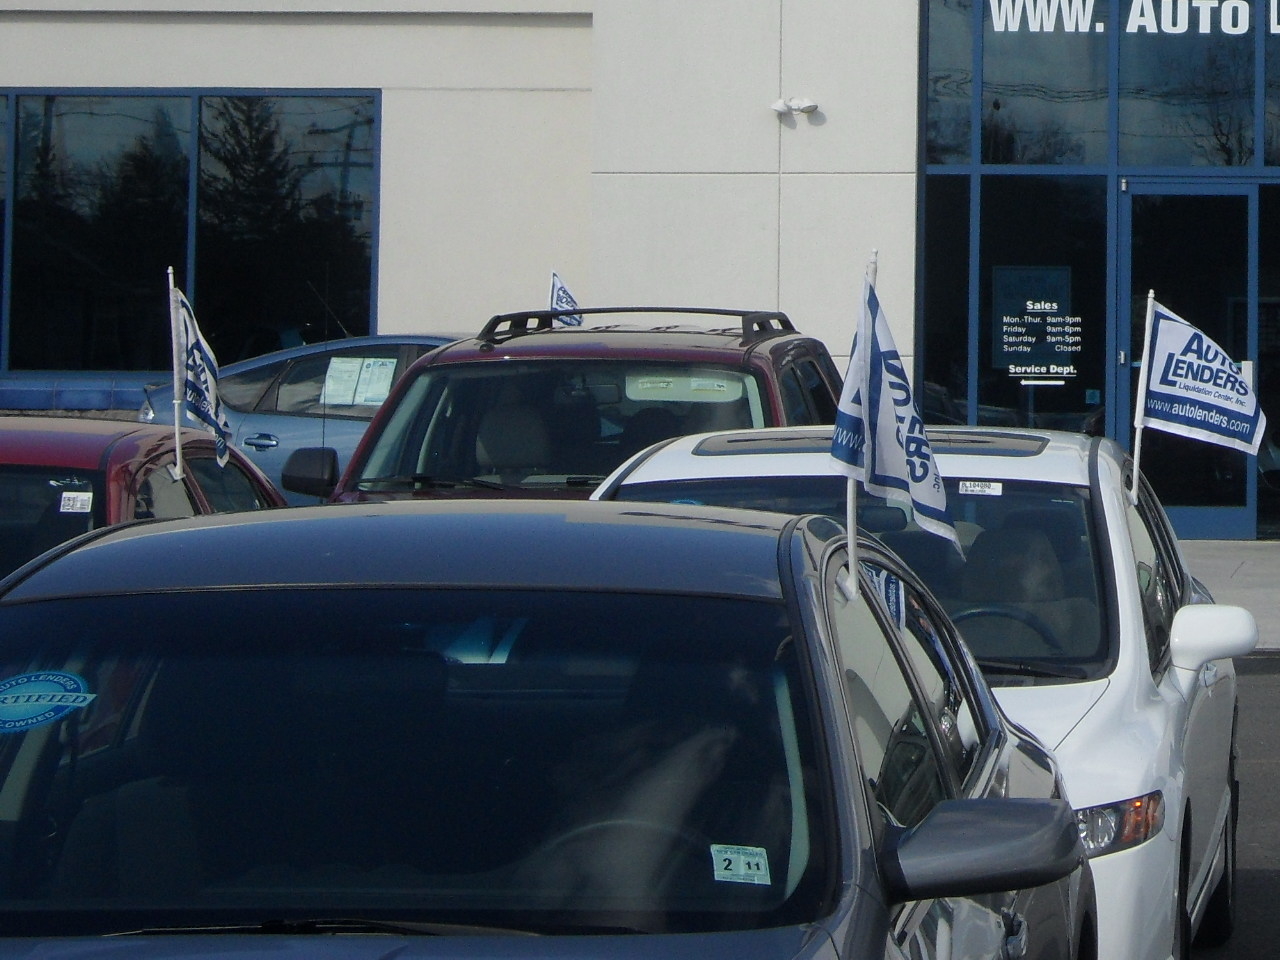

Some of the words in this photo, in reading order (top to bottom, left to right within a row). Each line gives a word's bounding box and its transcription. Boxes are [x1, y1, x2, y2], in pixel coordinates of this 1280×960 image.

[1026, 300, 1058, 310] Sales
[1046, 316, 1082, 325] 9am-9pm
[1003, 325, 1027, 334] Friday
[1046, 325, 1082, 334] 9am-6pm
[1003, 335, 1037, 344] Saturday
[1046, 335, 1082, 344] 9am-5pm
[1003, 344, 1032, 353] Sunday
[1055, 344, 1082, 352] Closed
[1008, 364, 1047, 374] Service
[1049, 364, 1078, 375] Dept.
[1158, 352, 1249, 397] LENDERS
[1178, 381, 1213, 397] Liquidation
[1147, 397, 1251, 435] www.autolenders.com
[31, 674, 77, 690] LENDERS
[0, 694, 89, 705] RTIFIED
[0, 711, 55, 728] -OWNED
[722, 857, 733, 871] 2
[745, 860, 761, 871] 11
